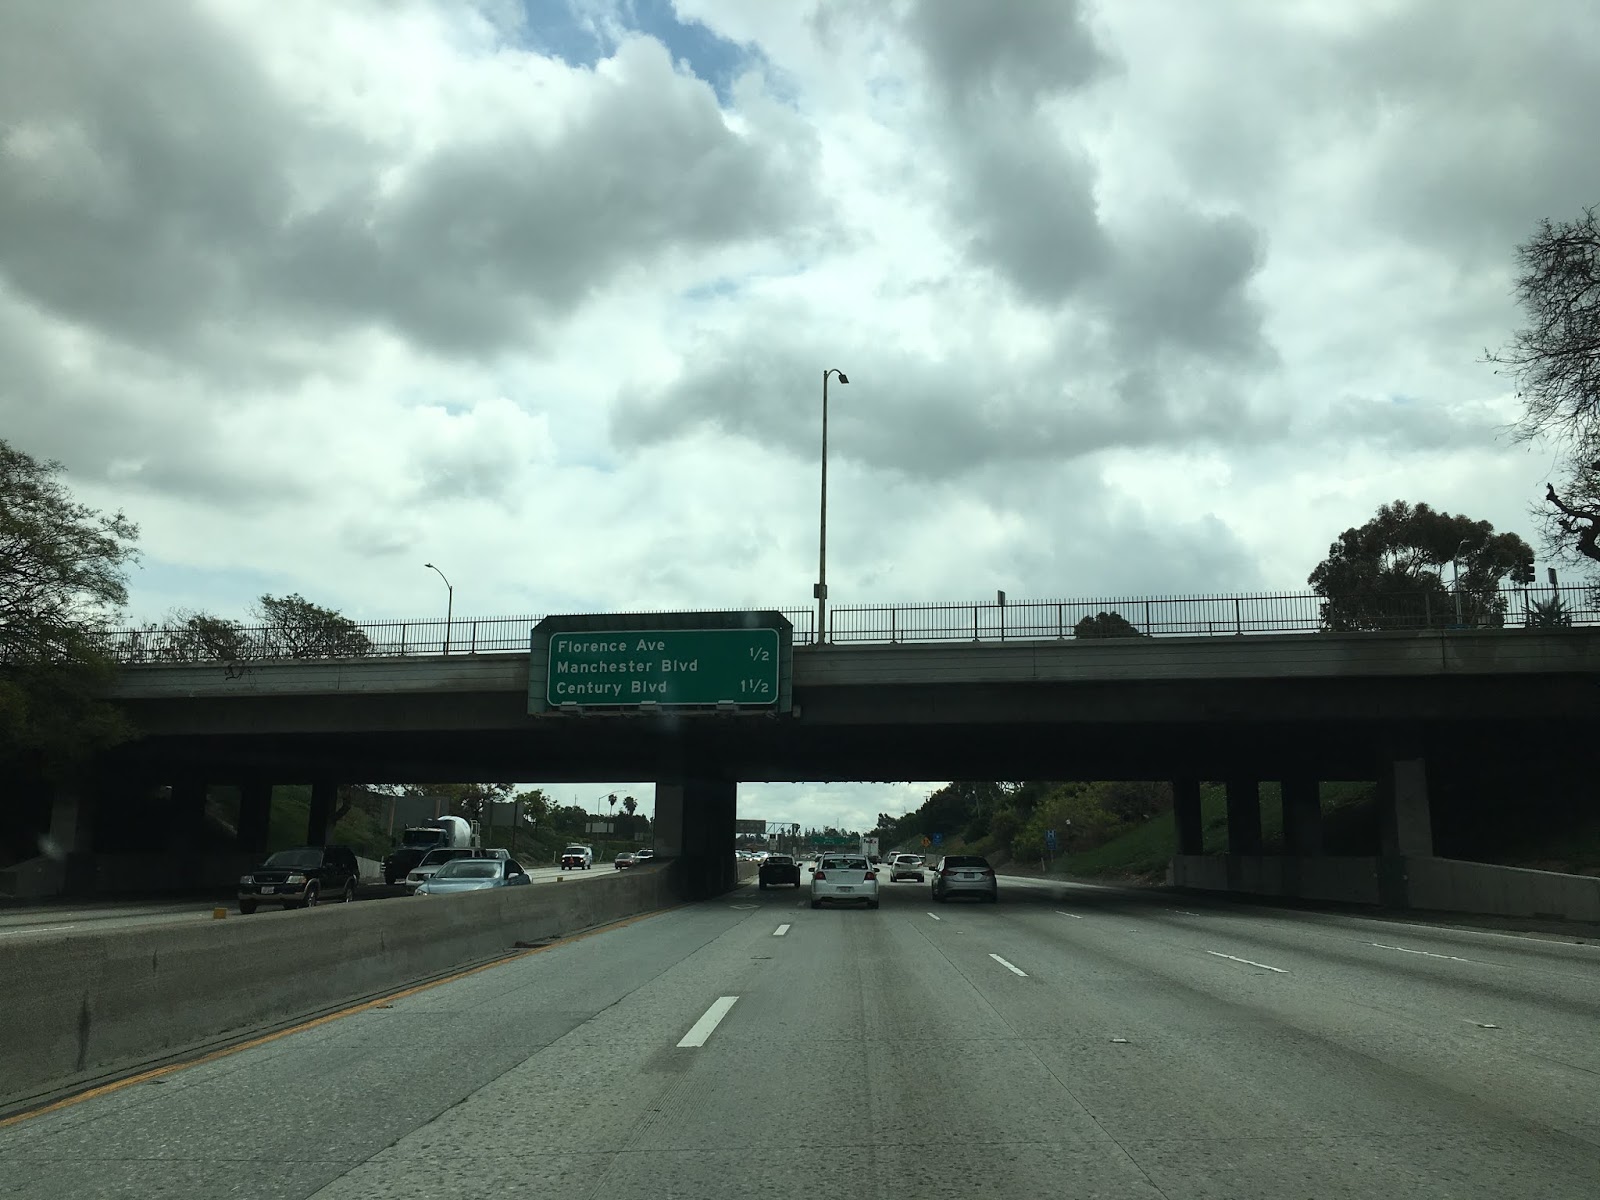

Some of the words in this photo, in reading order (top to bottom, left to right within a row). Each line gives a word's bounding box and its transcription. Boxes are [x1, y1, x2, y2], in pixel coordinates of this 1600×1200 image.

[558, 640, 627, 653] Florence
[636, 639, 665, 651] Ave
[557, 659, 652, 673] Manchester
[661, 659, 698, 672] Blvd
[556, 681, 622, 696] Century
[631, 681, 667, 693] Blvd
